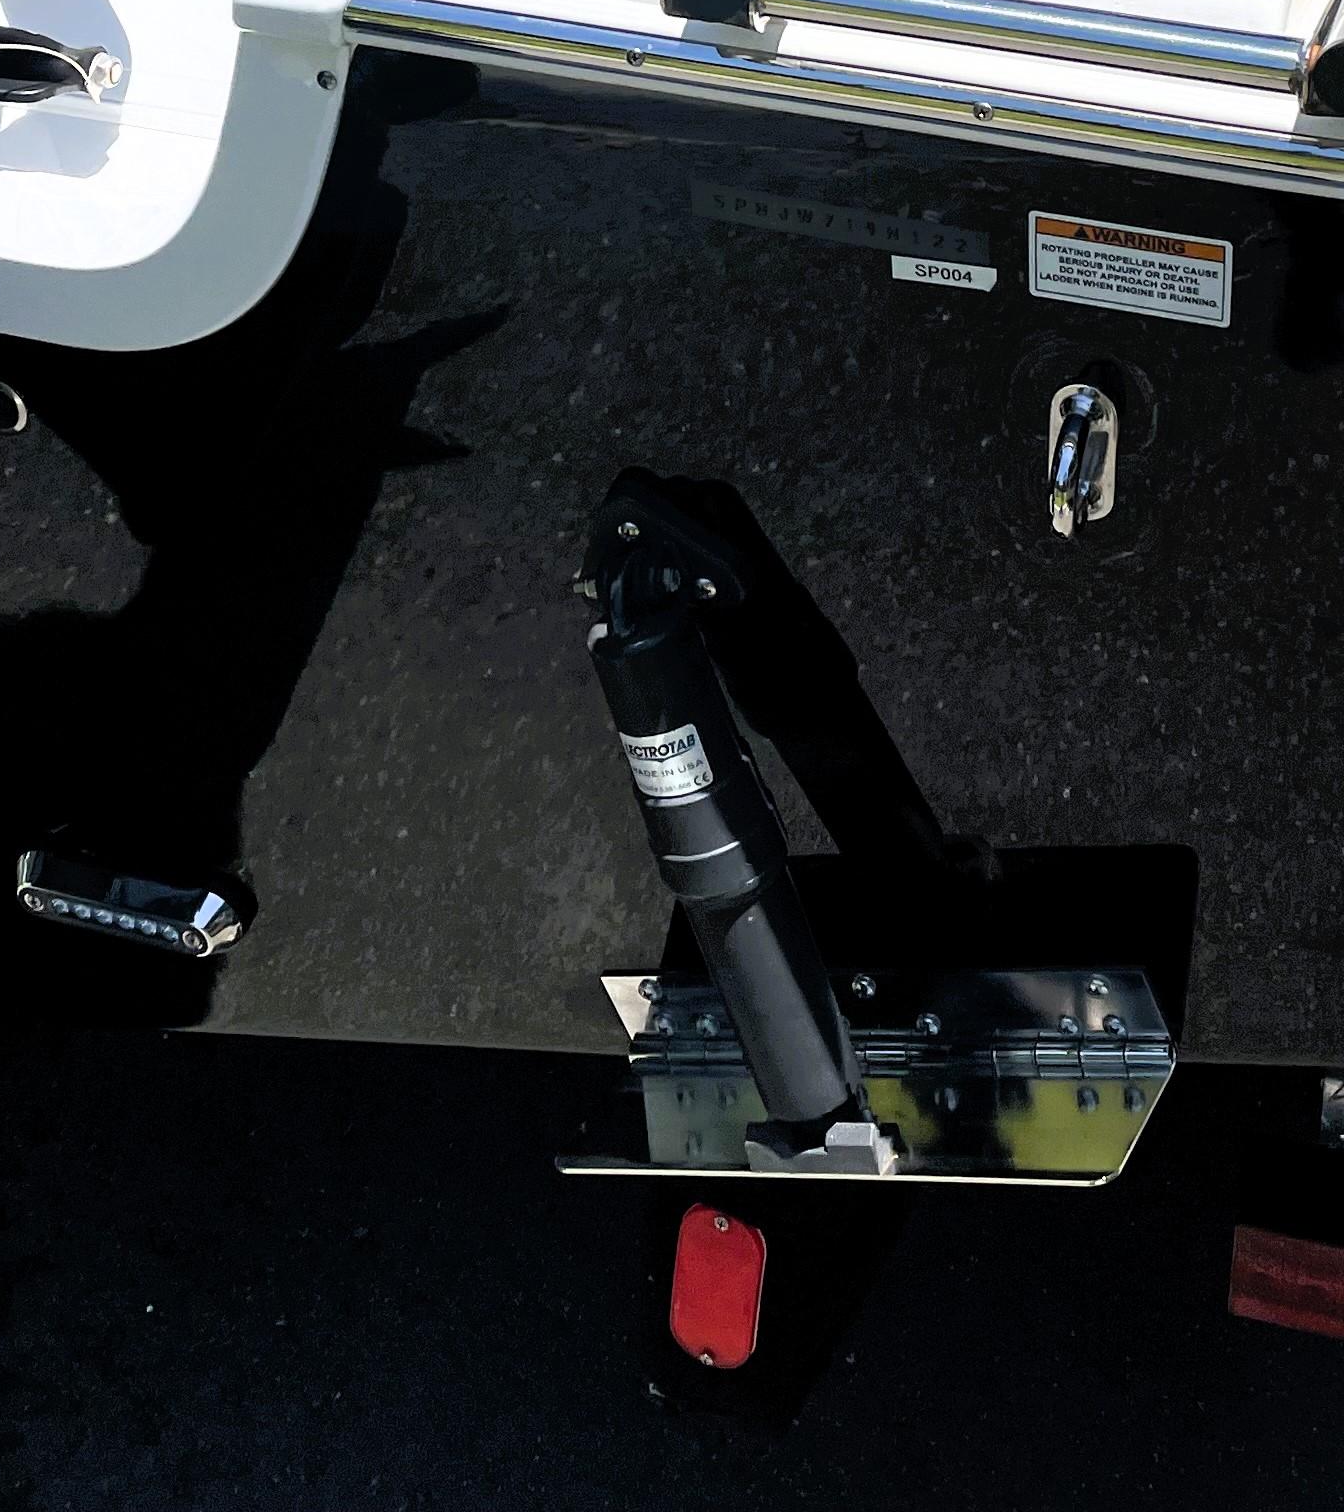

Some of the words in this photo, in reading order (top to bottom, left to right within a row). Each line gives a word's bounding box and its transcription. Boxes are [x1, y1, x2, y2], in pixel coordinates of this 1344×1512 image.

[1091, 228, 1186, 255] WARNING
[914, 263, 973, 284] SP004
[1041, 243, 1091, 258] ROTATING
[1094, 251, 1156, 268] PROPELLER
[1158, 261, 1181, 273] MAY
[1182, 266, 1219, 279] CAUSE
[1058, 256, 1103, 269] SERIOUS
[1105, 263, 1143, 276] INJURY
[1145, 270, 1161, 279] OR
[1163, 273, 1201, 286] DEATH.
[1039, 271, 1081, 286] LADDER
[1082, 279, 1114, 291] WHEN
[1116, 284, 1155, 298] ENGINE
[1157, 291, 1167, 300] IS
[1059, 265, 1074, 275] DO
[1076, 268, 1098, 278] NOT
[1100, 272, 1158, 288] APPROACH
[1160, 282, 1176, 291] OR
[1178, 284, 1200, 296] USE
[661, 768, 674, 776] IN
[678, 759, 705, 774] USA
